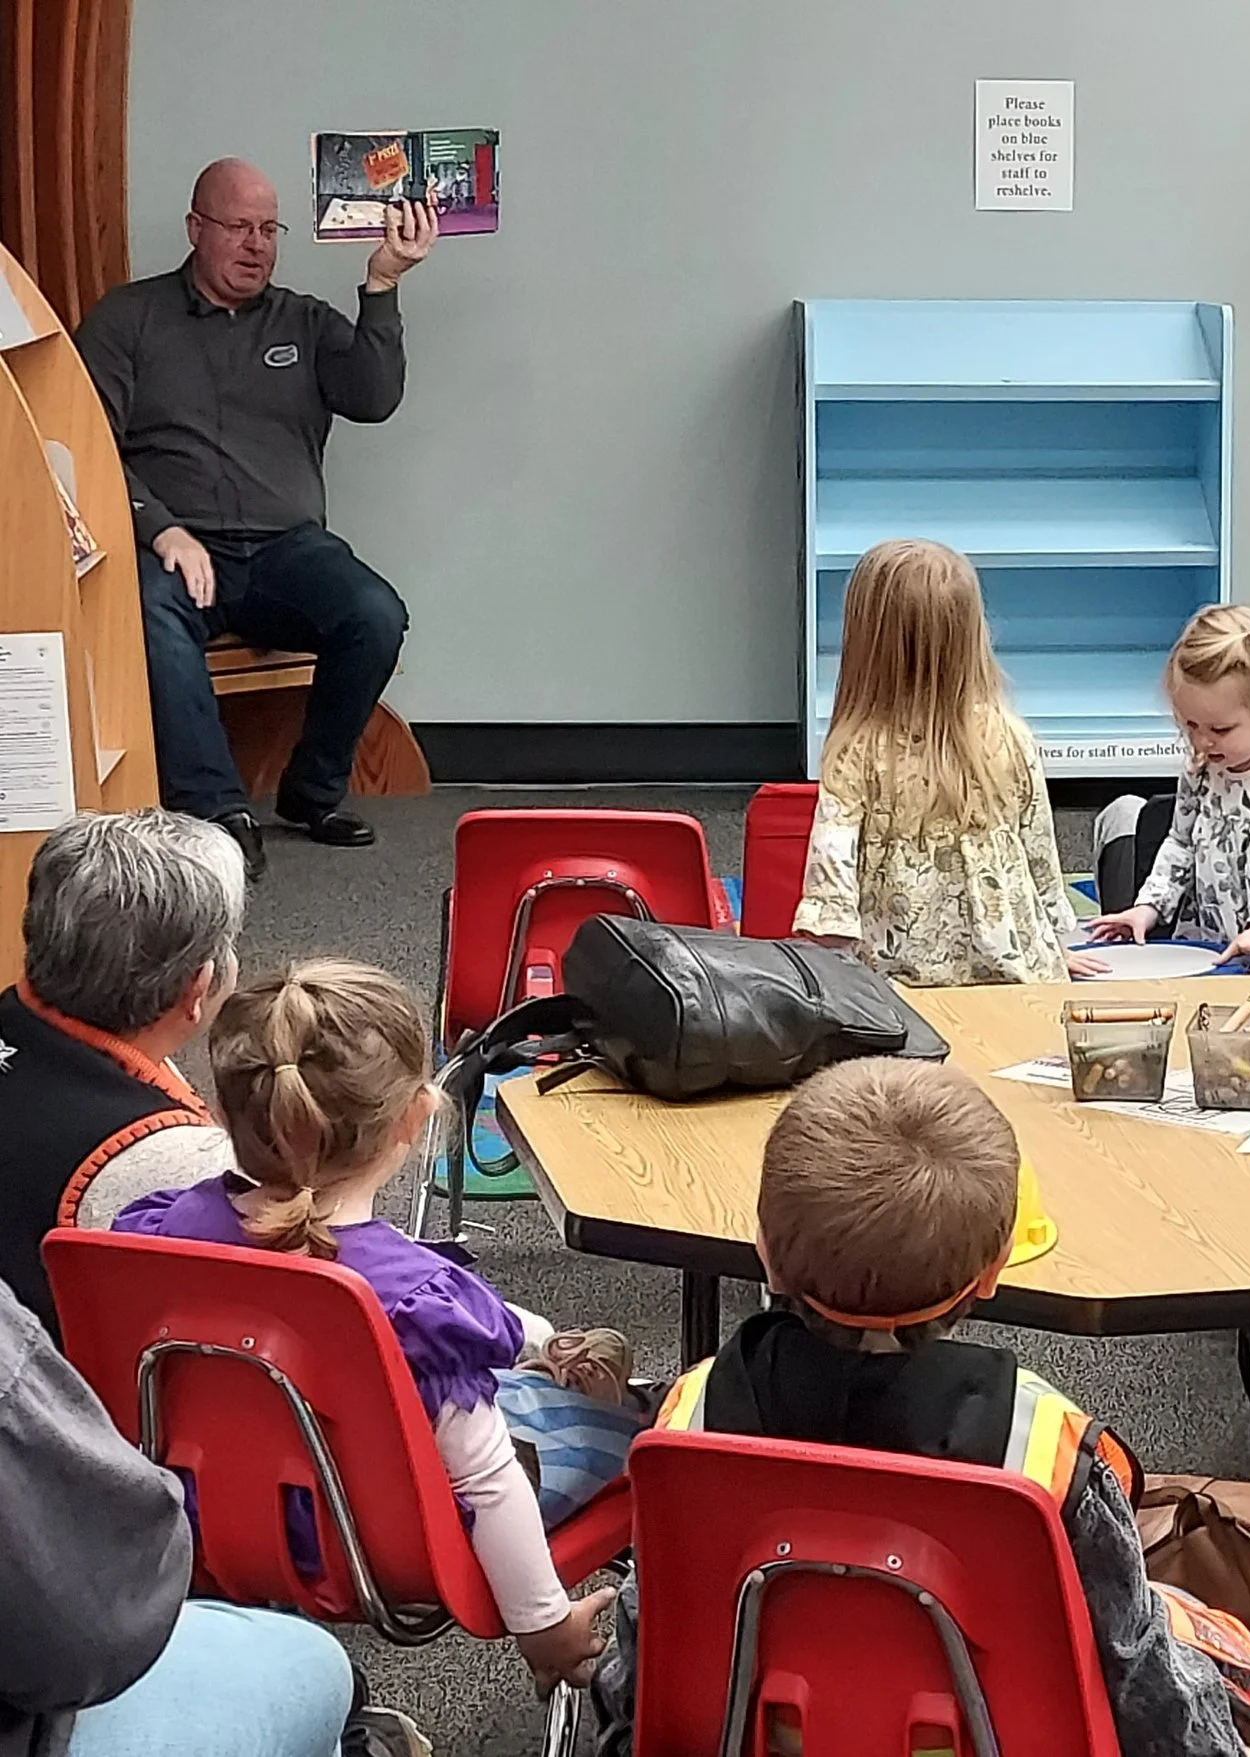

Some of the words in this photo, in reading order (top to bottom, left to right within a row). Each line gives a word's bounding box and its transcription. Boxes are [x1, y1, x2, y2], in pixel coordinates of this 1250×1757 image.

[1005, 97, 1045, 110] Please
[988, 114, 1021, 129] place
[1024, 114, 1062, 127] books
[1001, 135, 1018, 145] on
[1021, 132, 1048, 145] blue
[991, 150, 1036, 162] shelves
[1039, 150, 1058, 162] for
[1002, 167, 1031, 179] staff
[1034, 169, 1047, 179] to
[996, 184, 1052, 197] reshelve.
[1067, 745, 1085, 759] for
[1088, 744, 1118, 758] staff
[1121, 746, 1134, 757] to
